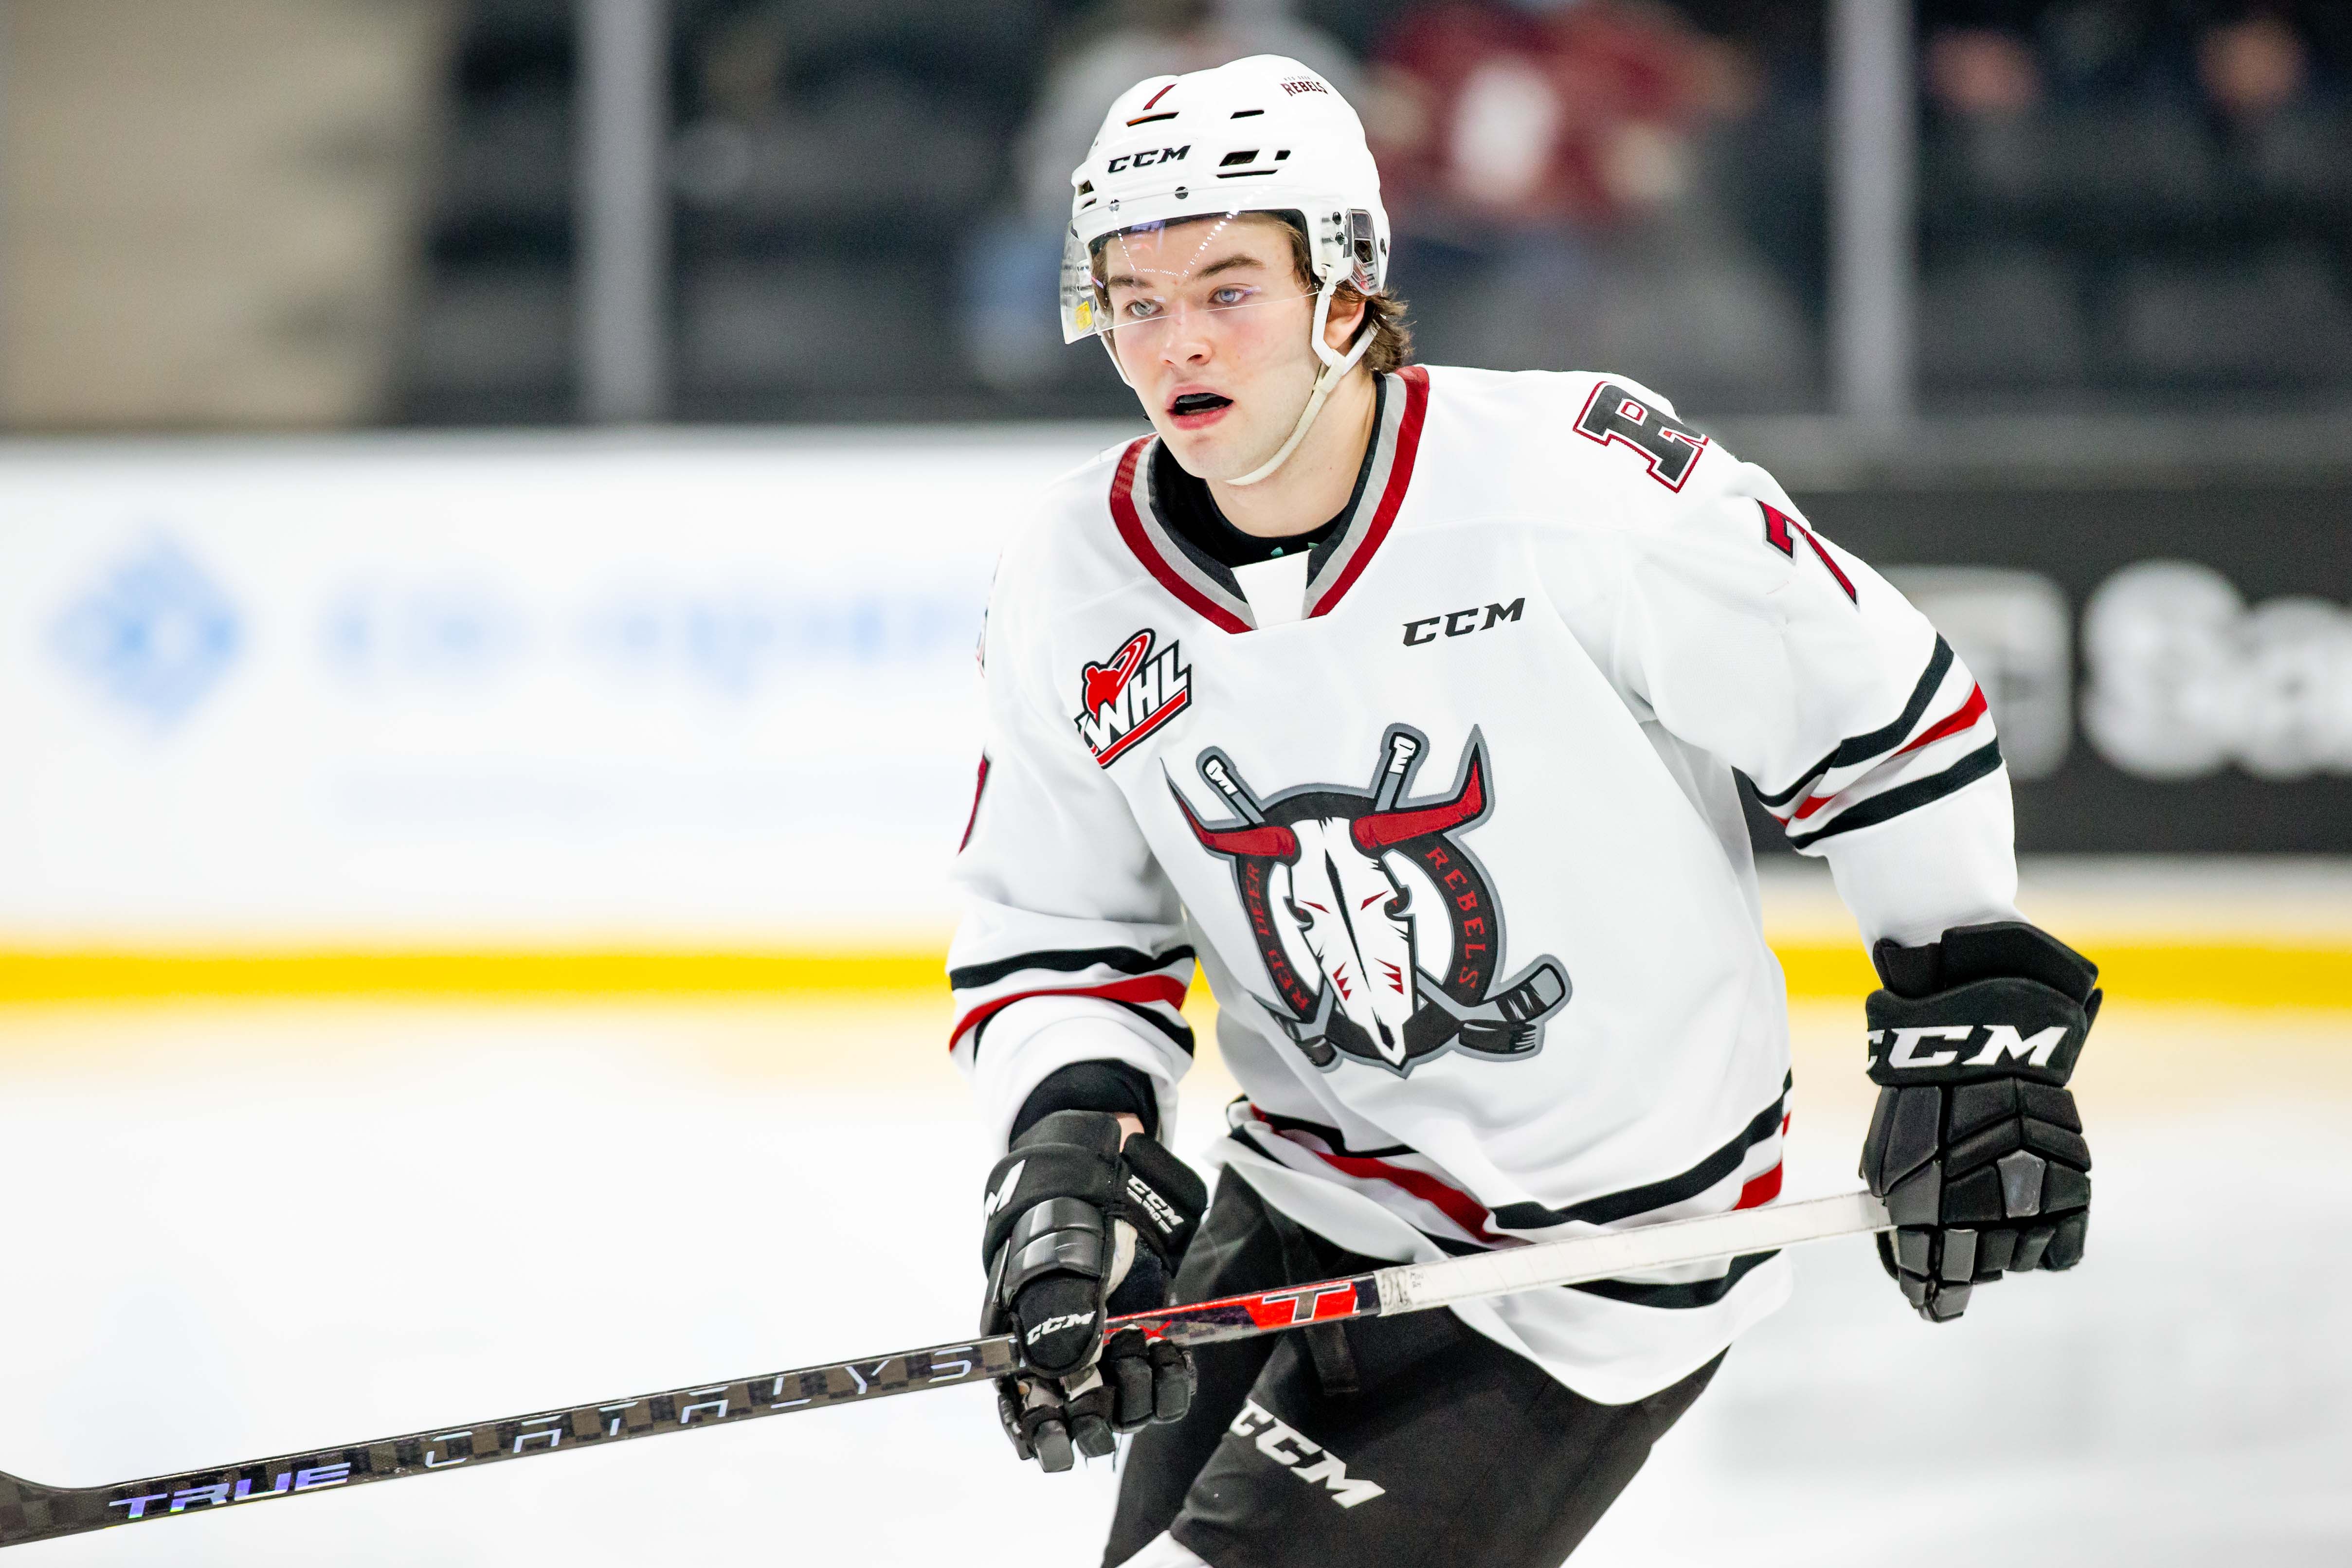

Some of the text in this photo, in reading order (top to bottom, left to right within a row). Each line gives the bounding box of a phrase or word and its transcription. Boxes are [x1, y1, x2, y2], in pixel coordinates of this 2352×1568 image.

[1280, 81, 1328, 97] REBELS
[1108, 145, 1191, 173] CCM
[1573, 381, 1709, 494] R
[1754, 497, 1860, 612] 7
[1402, 598, 1525, 647] CCM
[1077, 647, 1187, 752] WHL
[1425, 846, 1486, 988] REBELS
[1128, 1174, 1184, 1226] CCM
[1027, 1311, 1096, 1346] CCM
[109, 1338, 1026, 1510] TRUE CATALYS
[1229, 1398, 1386, 1508] CCM
